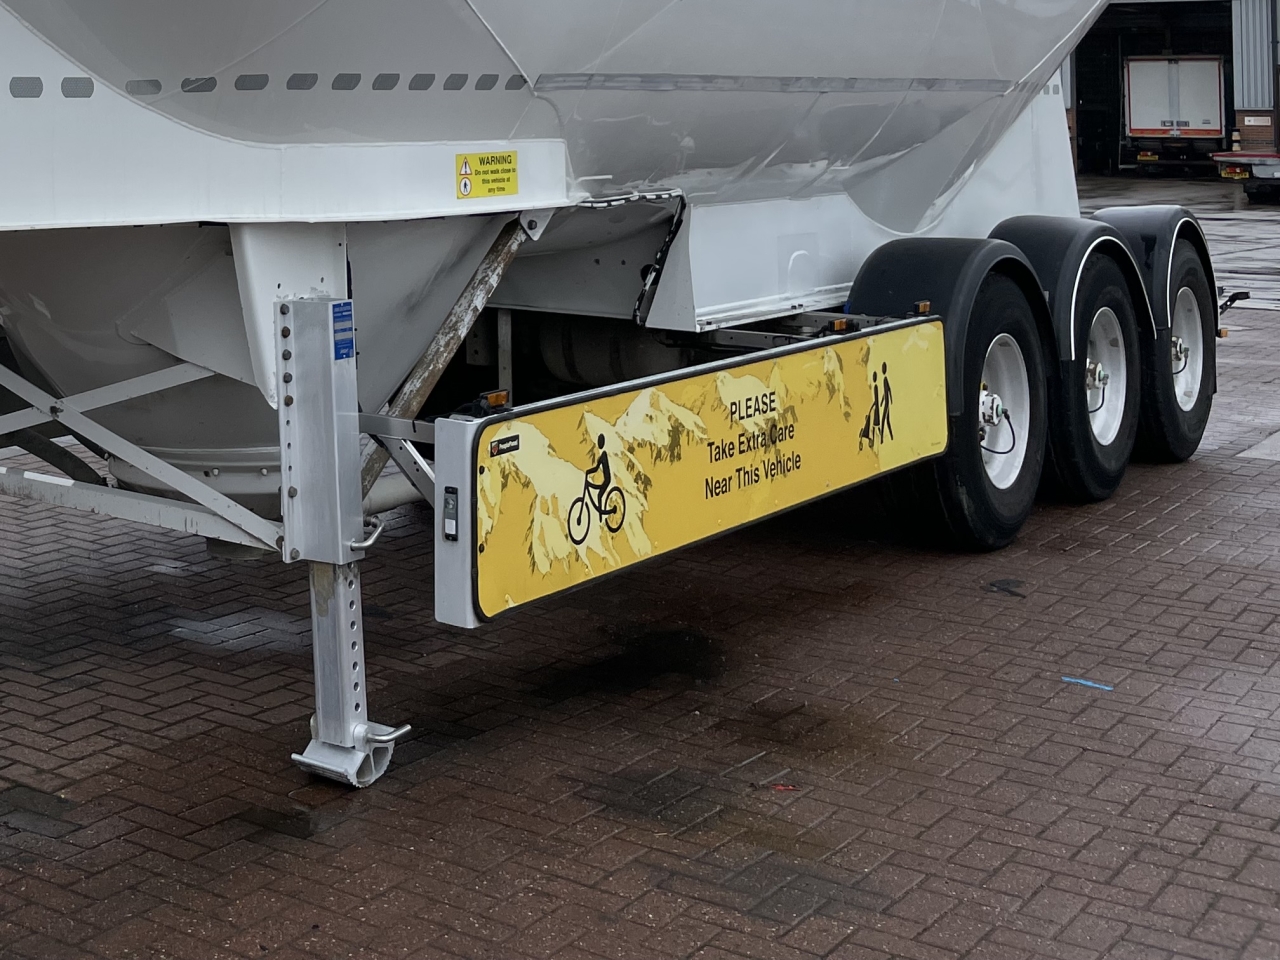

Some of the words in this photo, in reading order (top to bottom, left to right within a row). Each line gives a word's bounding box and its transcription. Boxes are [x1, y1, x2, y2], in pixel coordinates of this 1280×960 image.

[478, 154, 512, 166] WARNING
[729, 391, 776, 422] PLEASE
[706, 441, 735, 464] Take
[738, 429, 767, 454] Extra
[770, 423, 795, 445] Care
[705, 475, 733, 500] Near
[735, 464, 761, 488] This
[762, 450, 802, 481] Vehicle
